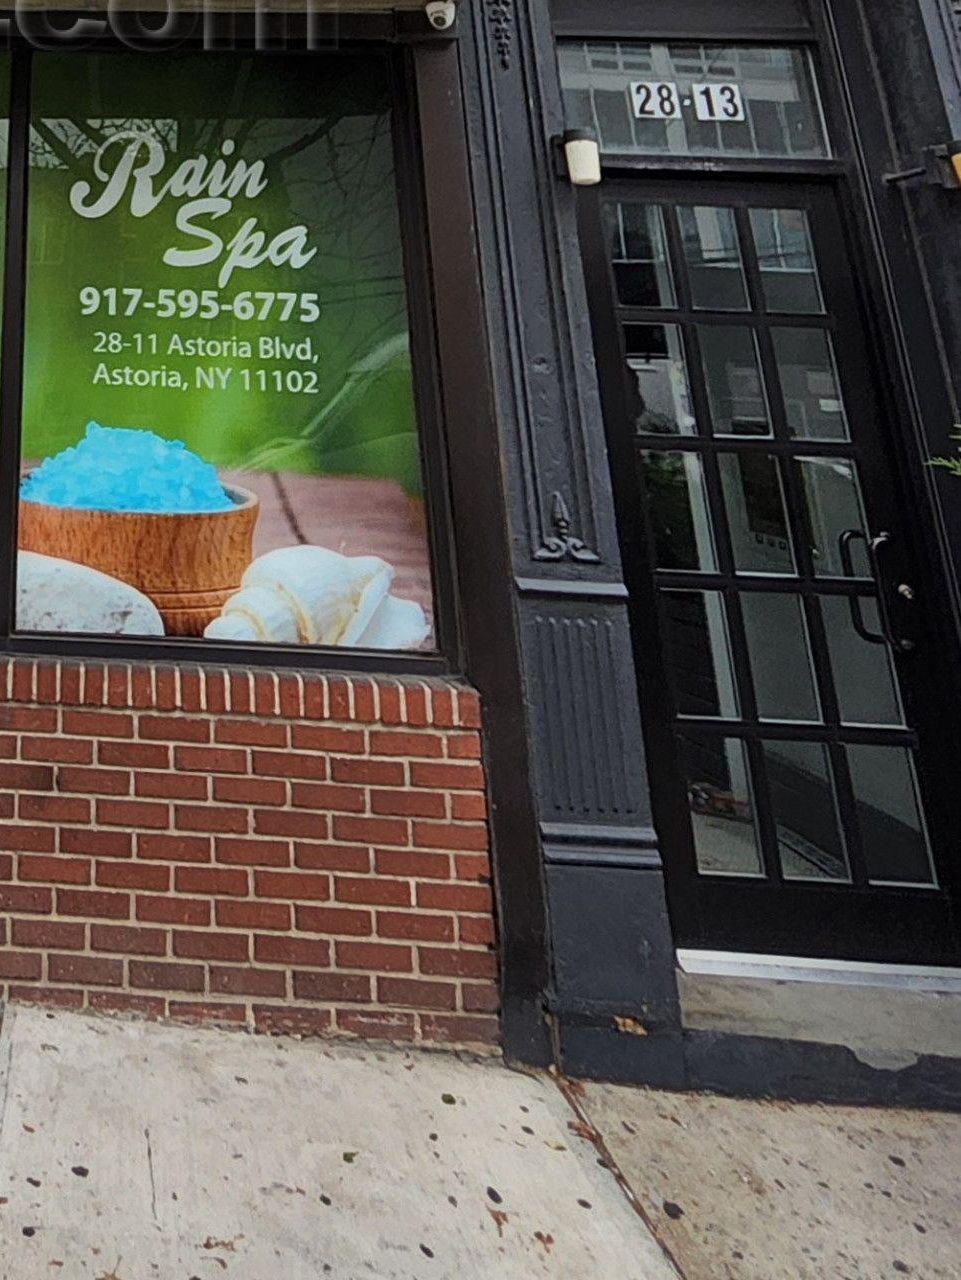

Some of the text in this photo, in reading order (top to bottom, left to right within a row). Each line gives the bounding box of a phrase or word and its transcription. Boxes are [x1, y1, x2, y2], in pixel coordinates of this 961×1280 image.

[69, 130, 269, 219] Rain
[162, 196, 318, 289] Spa
[79, 286, 321, 323] 917-595-6775
[92, 331, 319, 364] 28-11 Astoria Blvd,
[92, 362, 320, 394] Astoria, NY 11102
